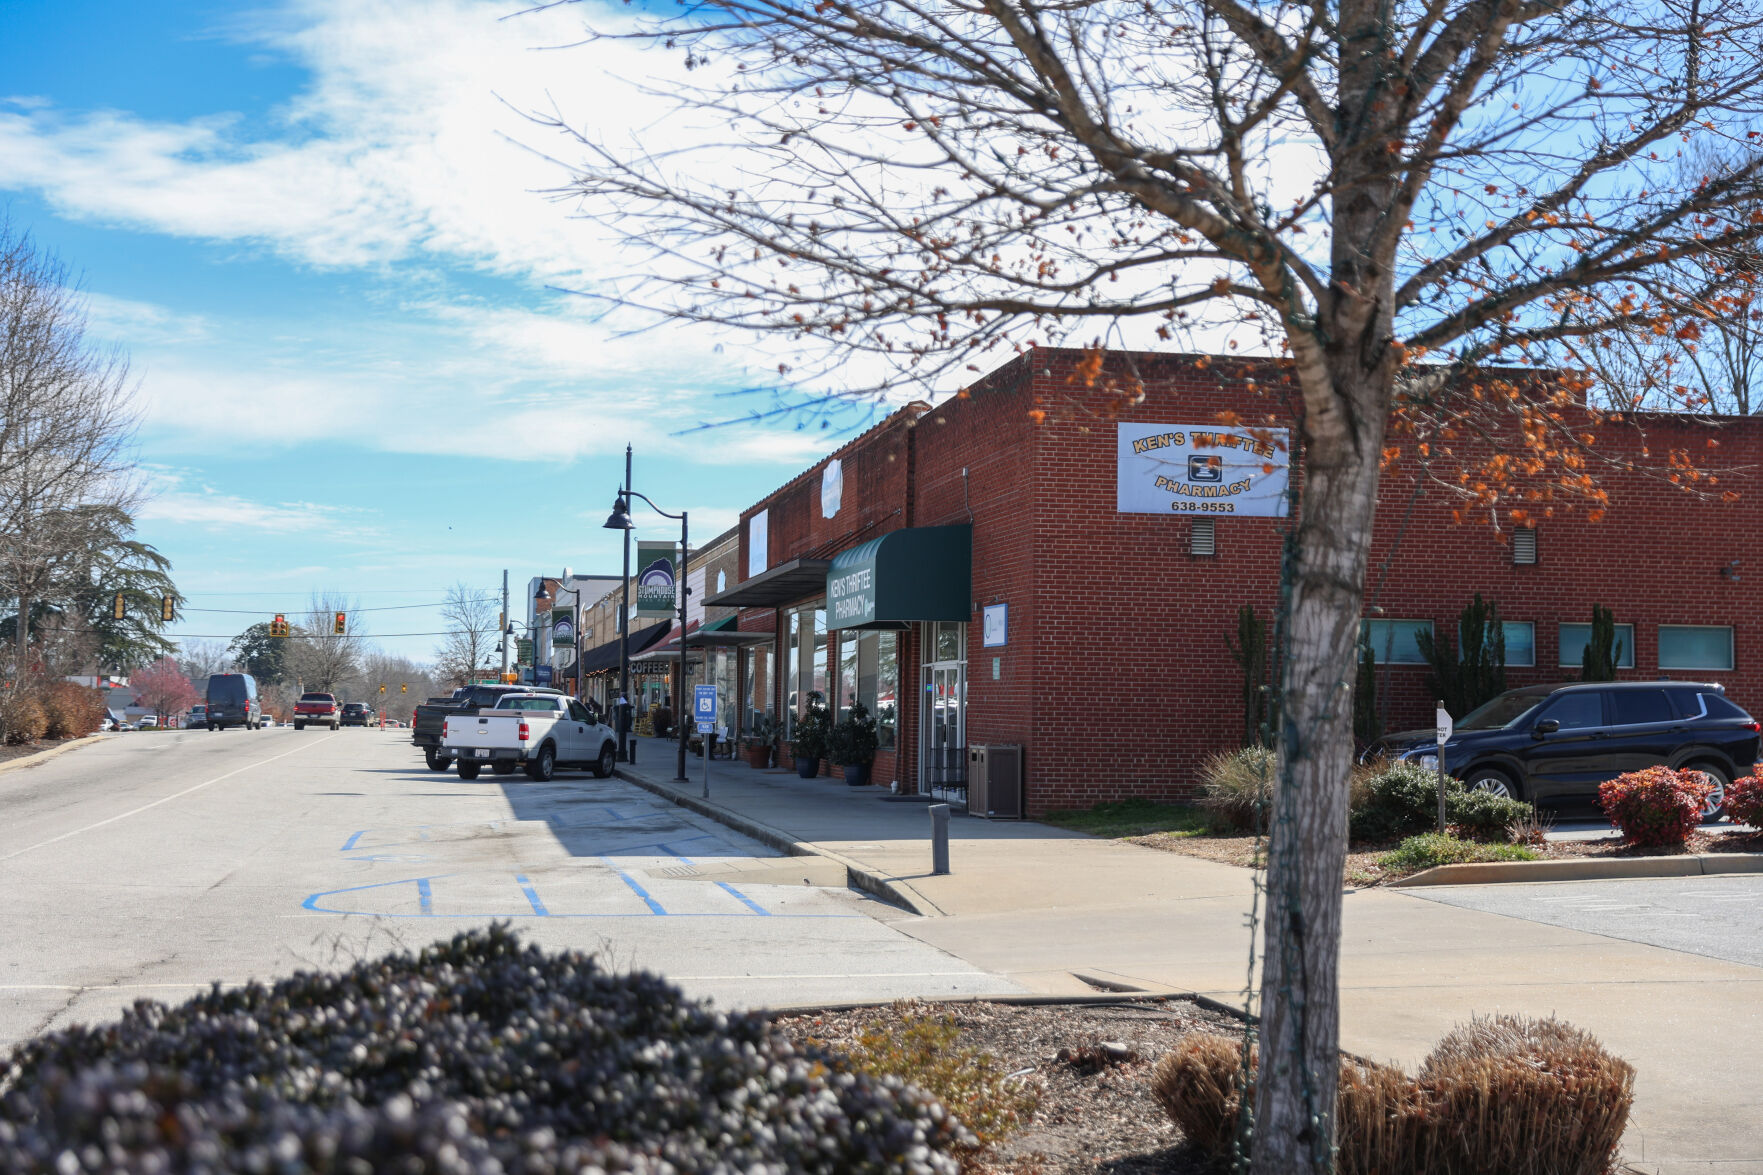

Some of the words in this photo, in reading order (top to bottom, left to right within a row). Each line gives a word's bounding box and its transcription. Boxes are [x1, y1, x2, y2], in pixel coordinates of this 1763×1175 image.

[1133, 432, 1186, 454] KEN'S
[1190, 432, 1275, 459] THRIFTEE
[1155, 475, 1250, 497] PHARMACY
[1171, 502, 1235, 512] 638-9553
[638, 586, 675, 595] STUMPHOUSE
[831, 577, 846, 598] KEN'S
[846, 568, 871, 595] THRIFTEE
[835, 594, 865, 620] PHARMACY
[630, 662, 664, 674] COFFEE
